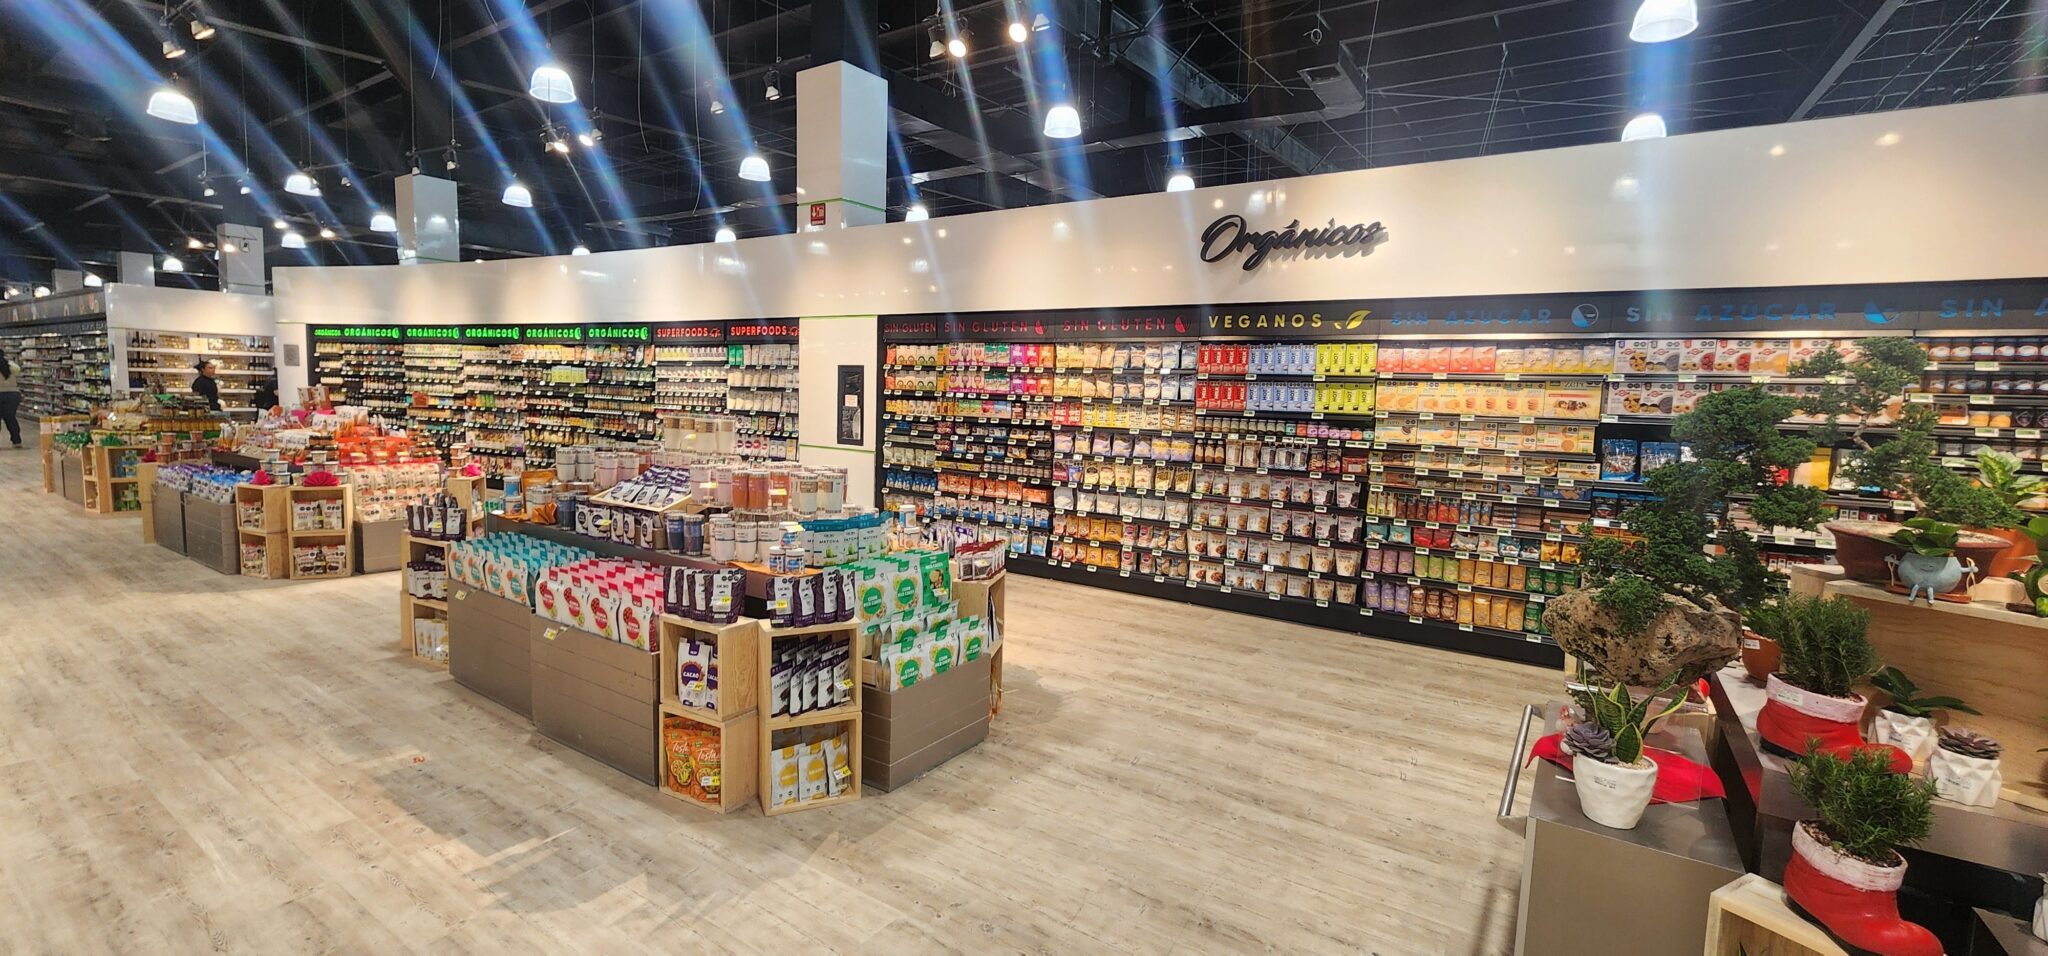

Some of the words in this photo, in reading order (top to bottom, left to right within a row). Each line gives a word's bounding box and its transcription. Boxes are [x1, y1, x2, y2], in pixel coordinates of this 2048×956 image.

[1200, 214, 1387, 271] Orgánicos
[1939, 297, 2004, 318] SIN
[1208, 313, 1322, 329] VEGANOS
[1392, 310, 1428, 326] SIN
[1626, 307, 1672, 322] SIN
[730, 325, 787, 337] SUPERFOODS
[883, 322, 899, 333] SIN
[901, 322, 936, 333] GLUTEN
[944, 321, 966, 333] SIN
[971, 320, 1028, 333] GLUTEN
[1063, 320, 1089, 332] SIN
[1097, 317, 1166, 331] GLUTEN
[343, 327, 392, 337] ORGÁNICOS
[406, 326, 453, 338] ORGÁNICOS
[465, 326, 512, 338] ORGÁNICOS
[525, 326, 575, 339] ORGÁNICOS
[588, 325, 641, 339] ORGÁNICOS
[656, 327, 709, 338] SUPERFOODS
